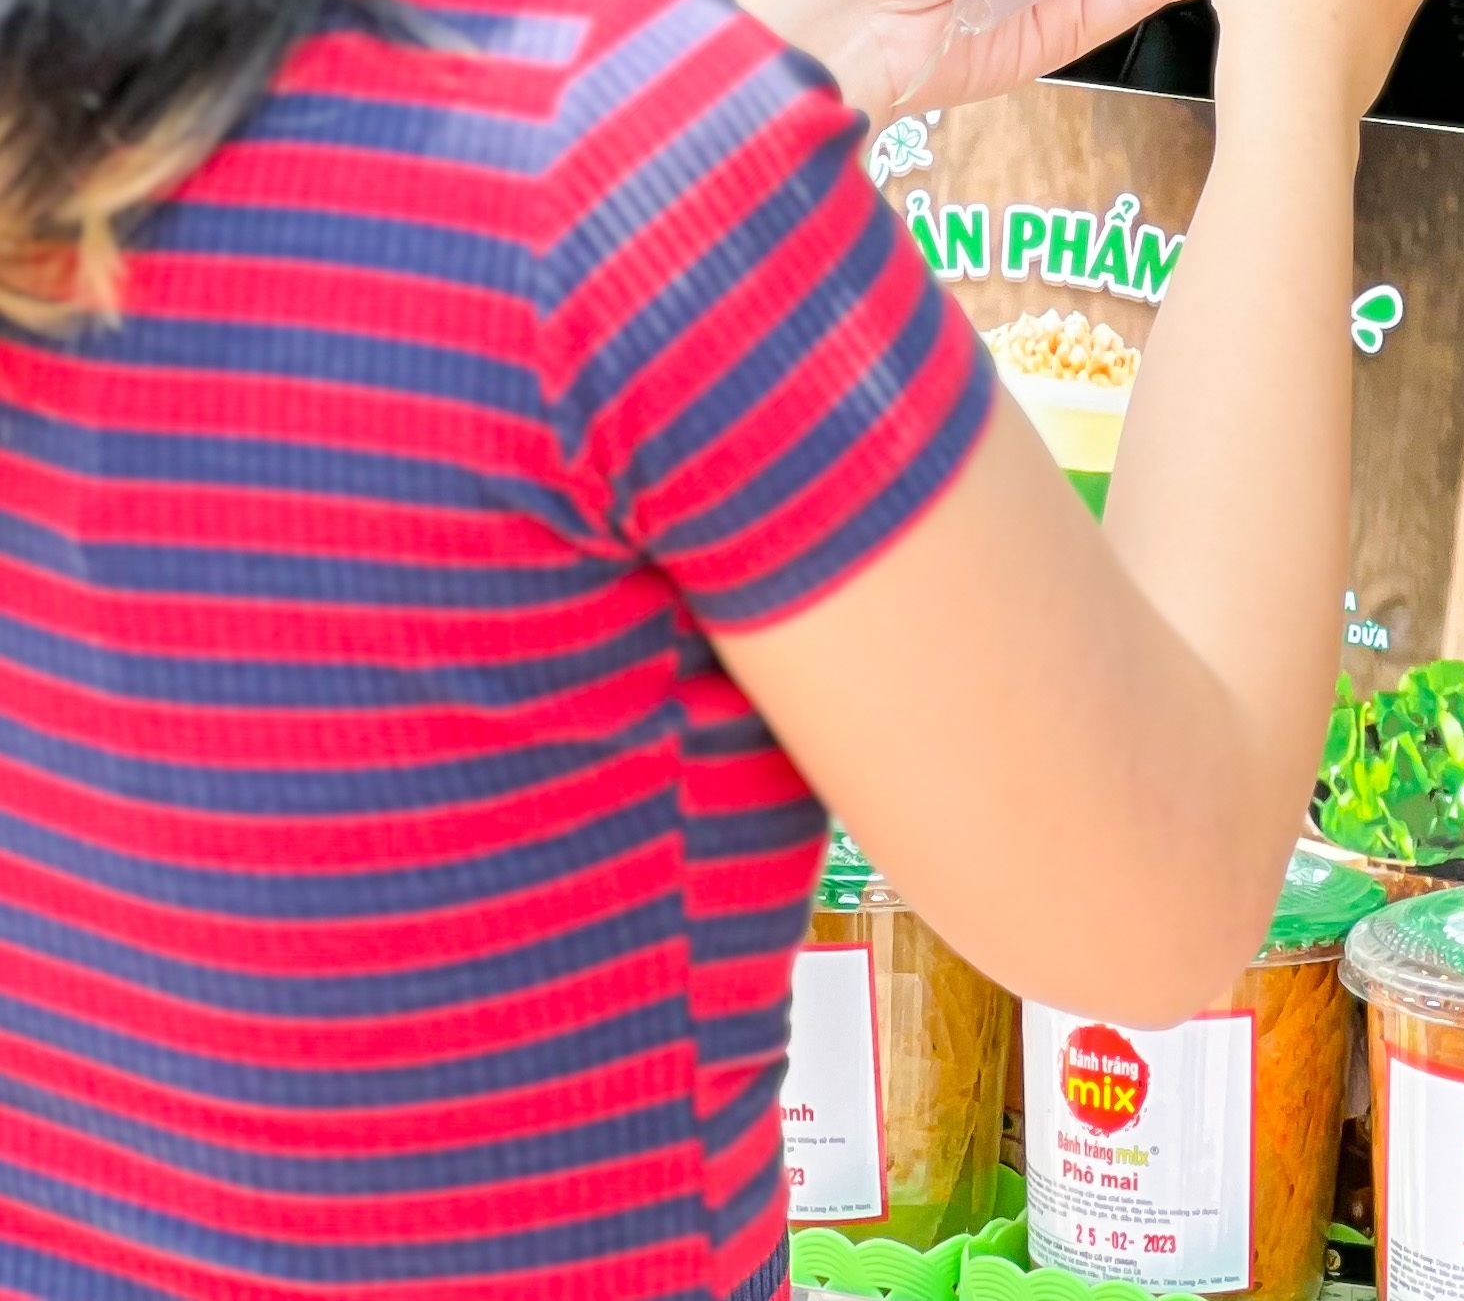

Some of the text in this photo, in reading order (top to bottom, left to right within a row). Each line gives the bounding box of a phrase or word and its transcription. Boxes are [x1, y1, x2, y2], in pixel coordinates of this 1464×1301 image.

[909, 194, 985, 273] ẢN
[1069, 1047, 1139, 1080] Bánh tráng
[1067, 1075, 1136, 1113] mix
[1057, 1130, 1081, 1155] Bánh
[1084, 1139, 1113, 1165] tráng
[1062, 1159, 1139, 1192] Phô mai
[1143, 1234, 1177, 1254] 2023
